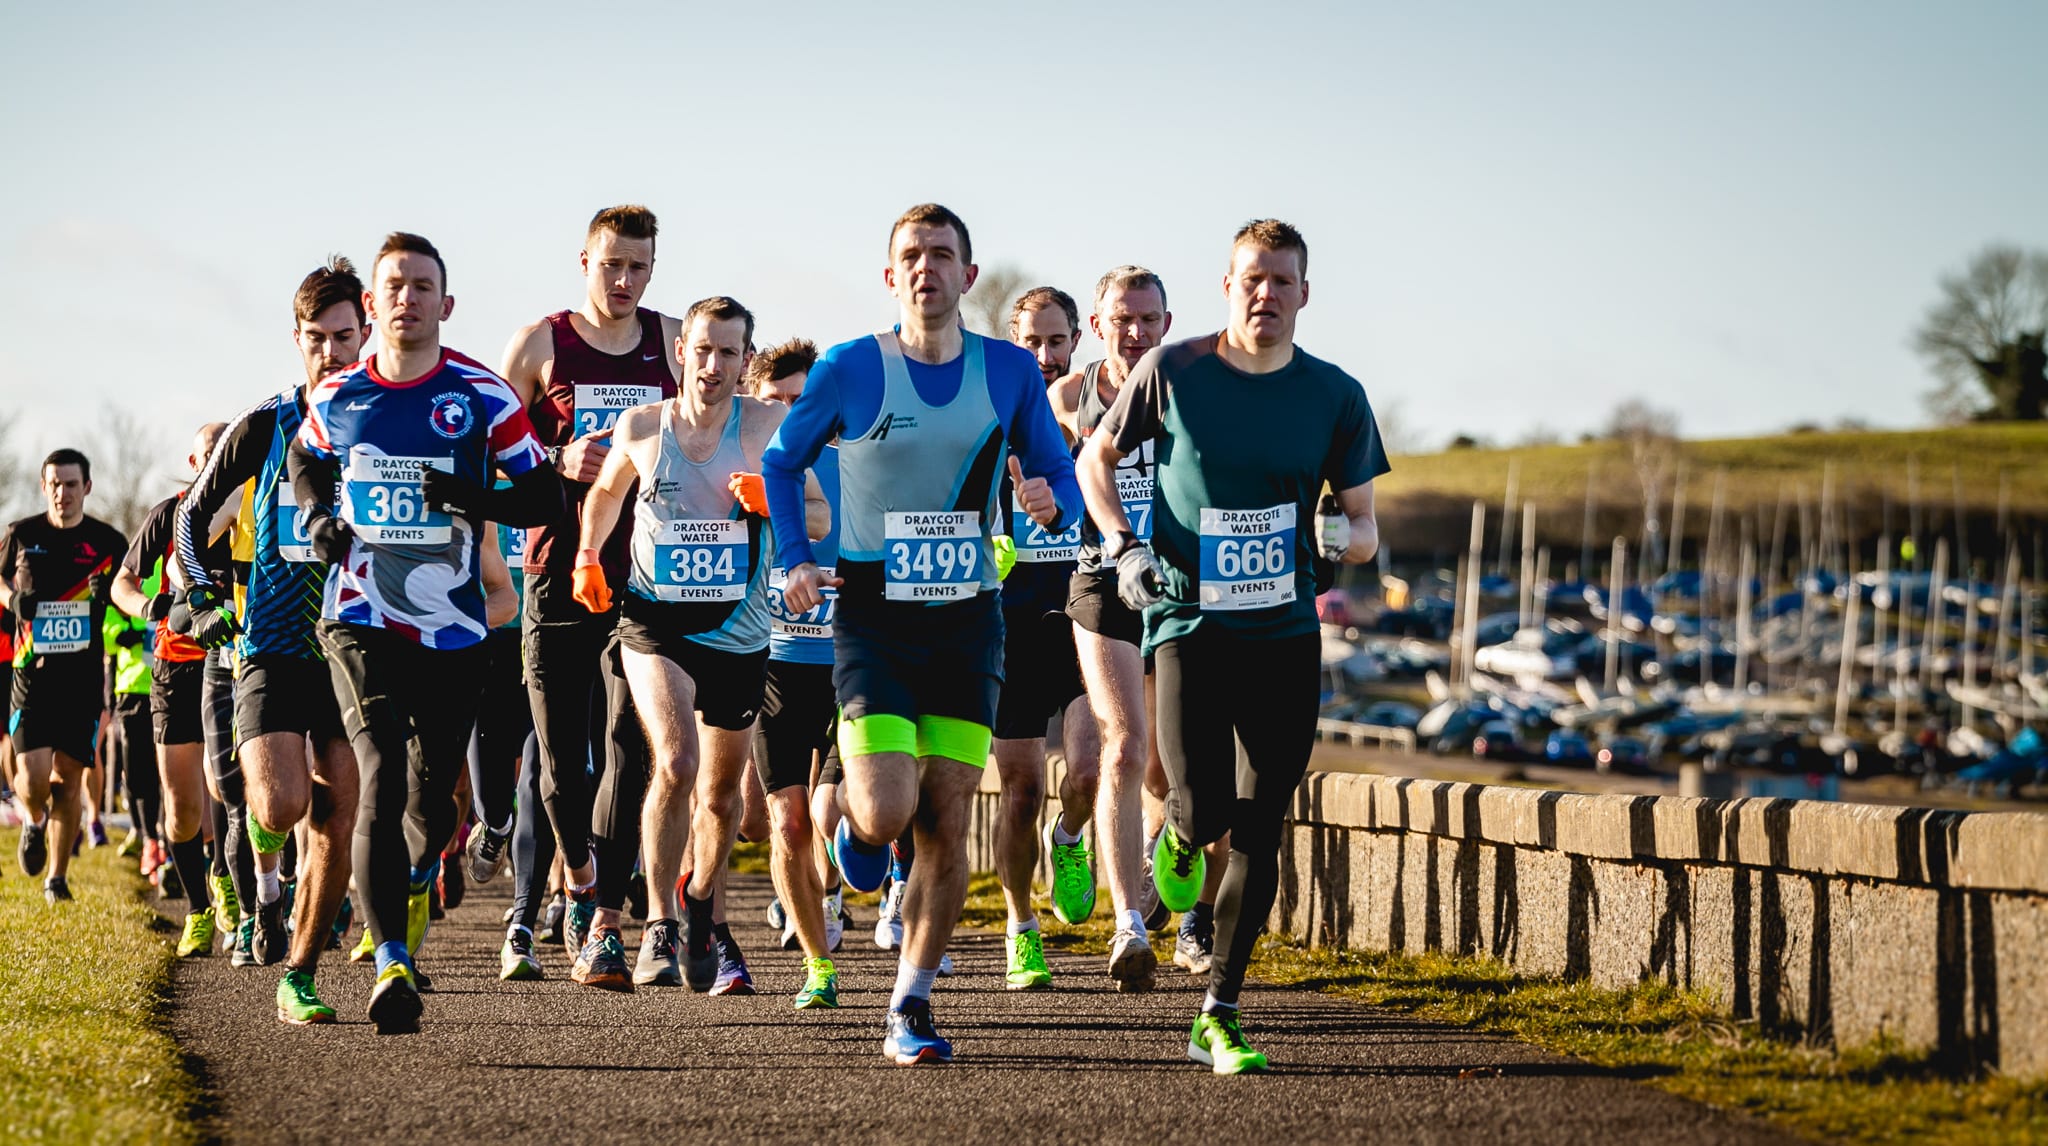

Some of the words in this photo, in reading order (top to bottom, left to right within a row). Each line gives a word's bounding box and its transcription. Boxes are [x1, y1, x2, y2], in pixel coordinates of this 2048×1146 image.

[593, 388, 647, 397] DRAYCOTE
[603, 398, 639, 407] WATER
[381, 470, 421, 481] WATER
[904, 514, 965, 525] DRAYCOTE
[1222, 509, 1280, 522] DRAYCOTE
[673, 522, 731, 532] DRAYCOTE
[915, 526, 955, 536] WATER
[1230, 522, 1271, 534] WATER
[379, 530, 425, 540] EVENTS
[680, 533, 719, 543] WATER
[1036, 549, 1073, 559] EVENTS
[1216, 536, 1286, 578] 666
[670, 548, 735, 583] 384
[890, 541, 977, 580] 3499
[681, 588, 723, 598] EVENTS
[913, 586, 957, 597] EVENTS
[1231, 581, 1276, 595] EVENTS
[41, 617, 82, 640] 460
[784, 625, 822, 635] EVENTS
